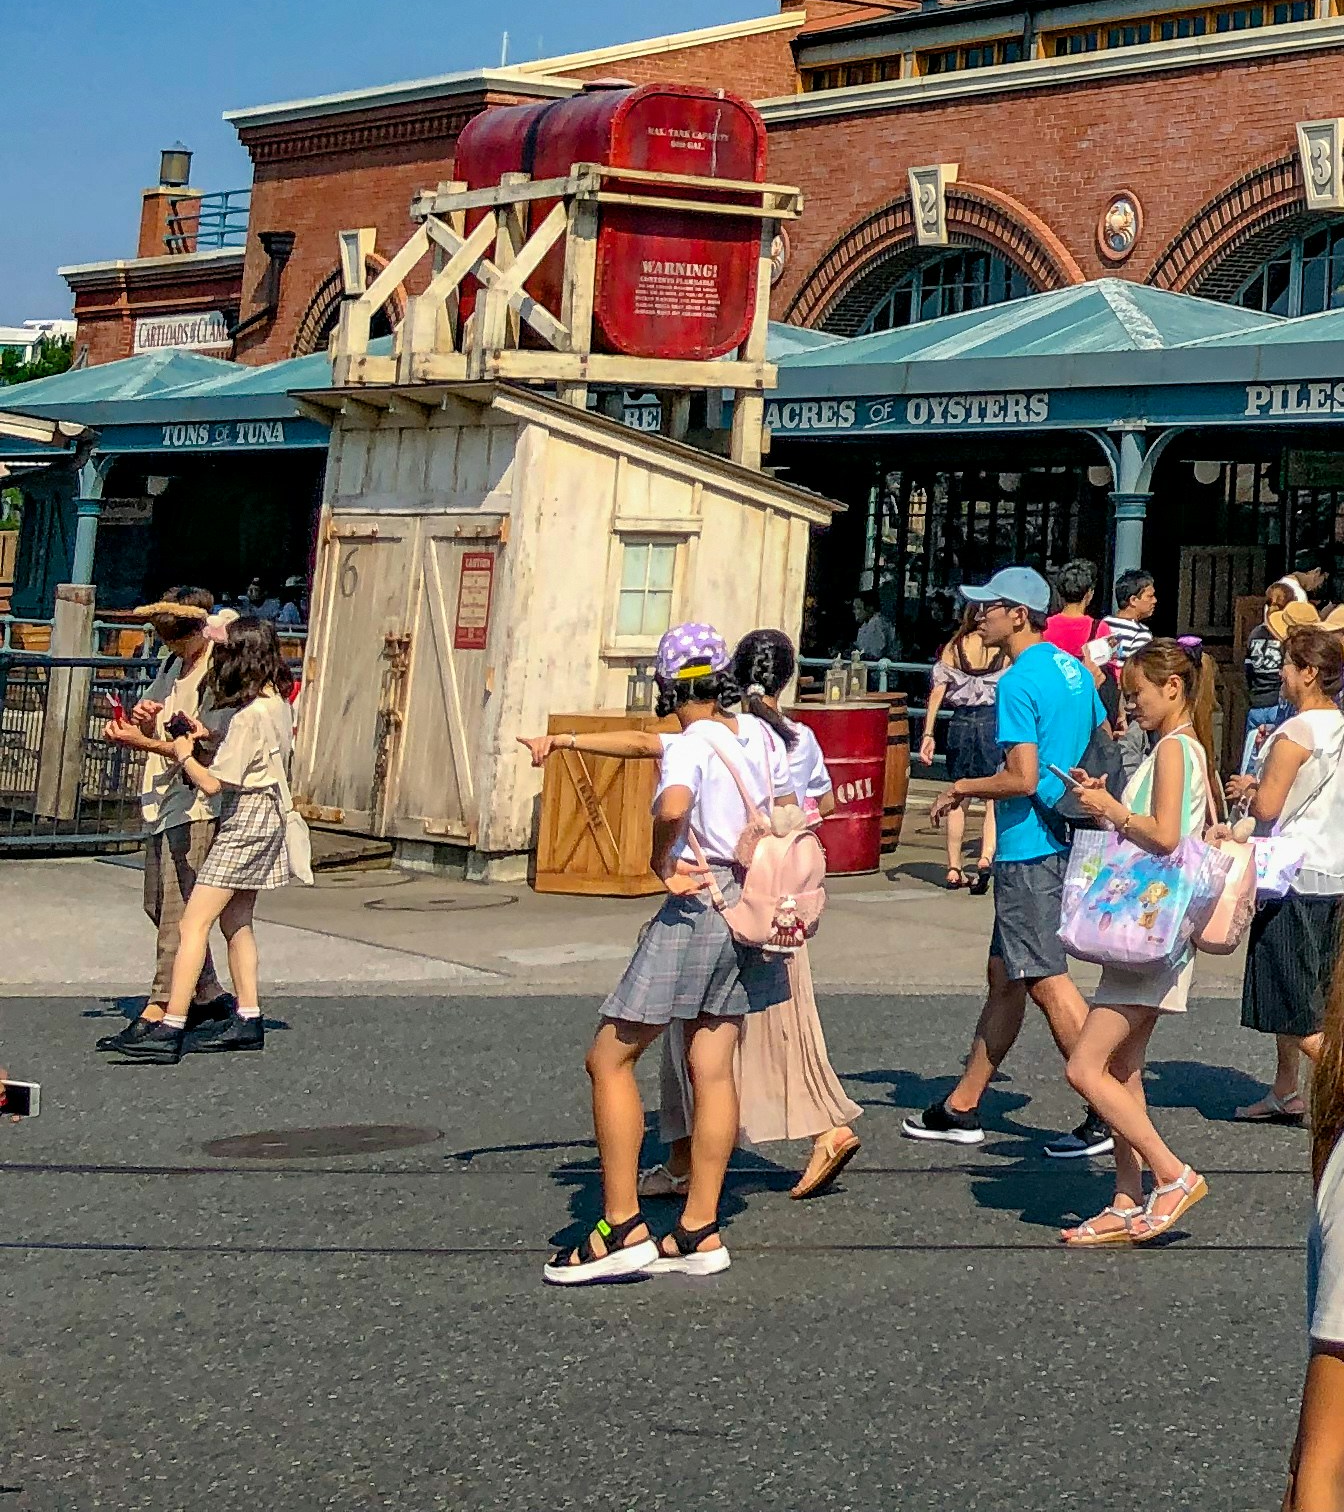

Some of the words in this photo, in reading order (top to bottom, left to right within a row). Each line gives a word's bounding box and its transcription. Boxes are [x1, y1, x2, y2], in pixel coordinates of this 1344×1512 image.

[641, 260, 719, 278] WARNING!
[764, 399, 857, 430] ACRES
[869, 400, 893, 422] OF
[905, 391, 1050, 425] OYSTERS
[162, 424, 210, 447] TONS
[236, 421, 285, 444] TUNA
[340, 546, 359, 598] 6
